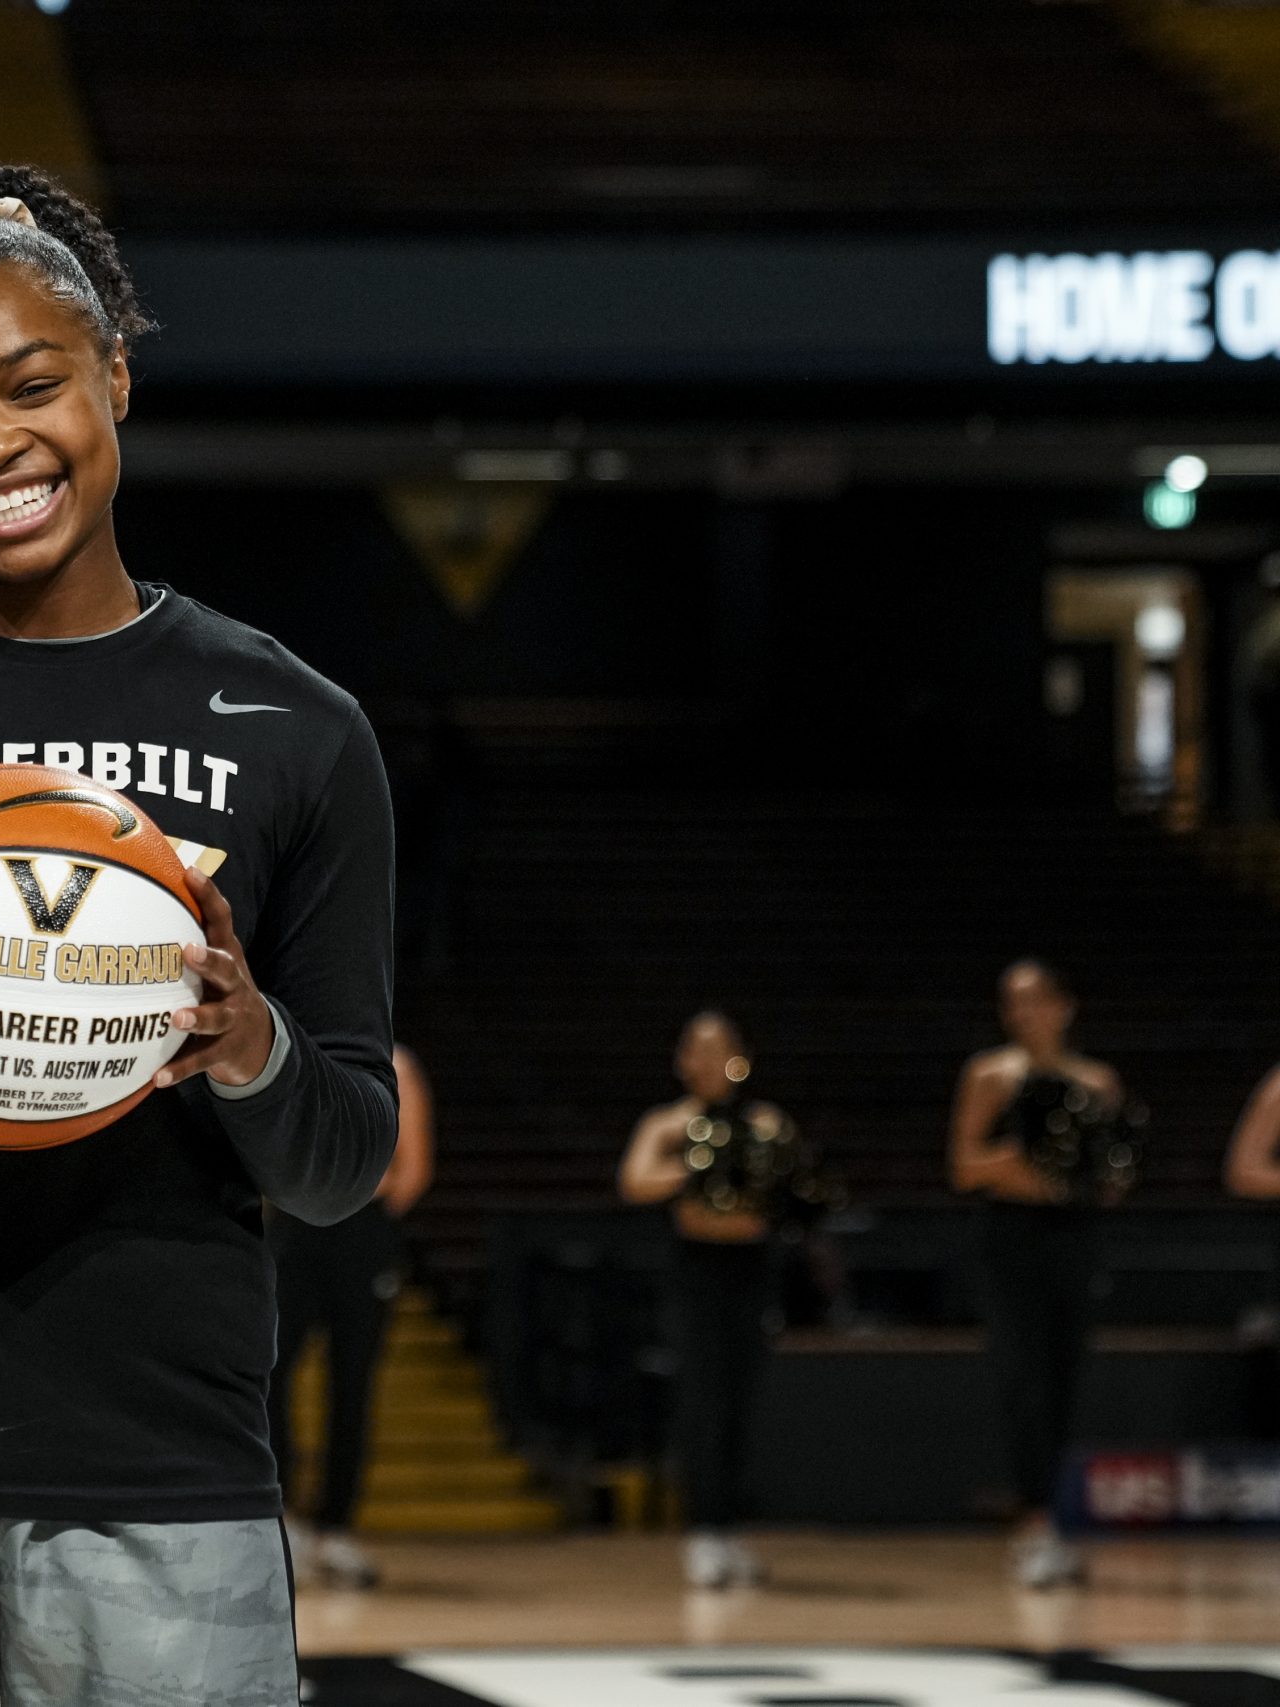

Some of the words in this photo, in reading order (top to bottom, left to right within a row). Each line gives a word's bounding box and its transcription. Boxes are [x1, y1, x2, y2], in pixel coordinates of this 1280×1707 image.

[986, 251, 1215, 365] HOME
[1216, 249, 1280, 361] O
[54, 942, 183, 986] GARRAUD
[88, 1010, 172, 1045] POINTS
[13, 1058, 37, 1079] VS.
[42, 1060, 101, 1080] AUSTIN
[101, 1056, 138, 1079] PEAY
[16, 1102, 89, 1112] GYMNASIUM
[30, 1091, 47, 1102] 17,
[51, 1092, 83, 1101] 2022
